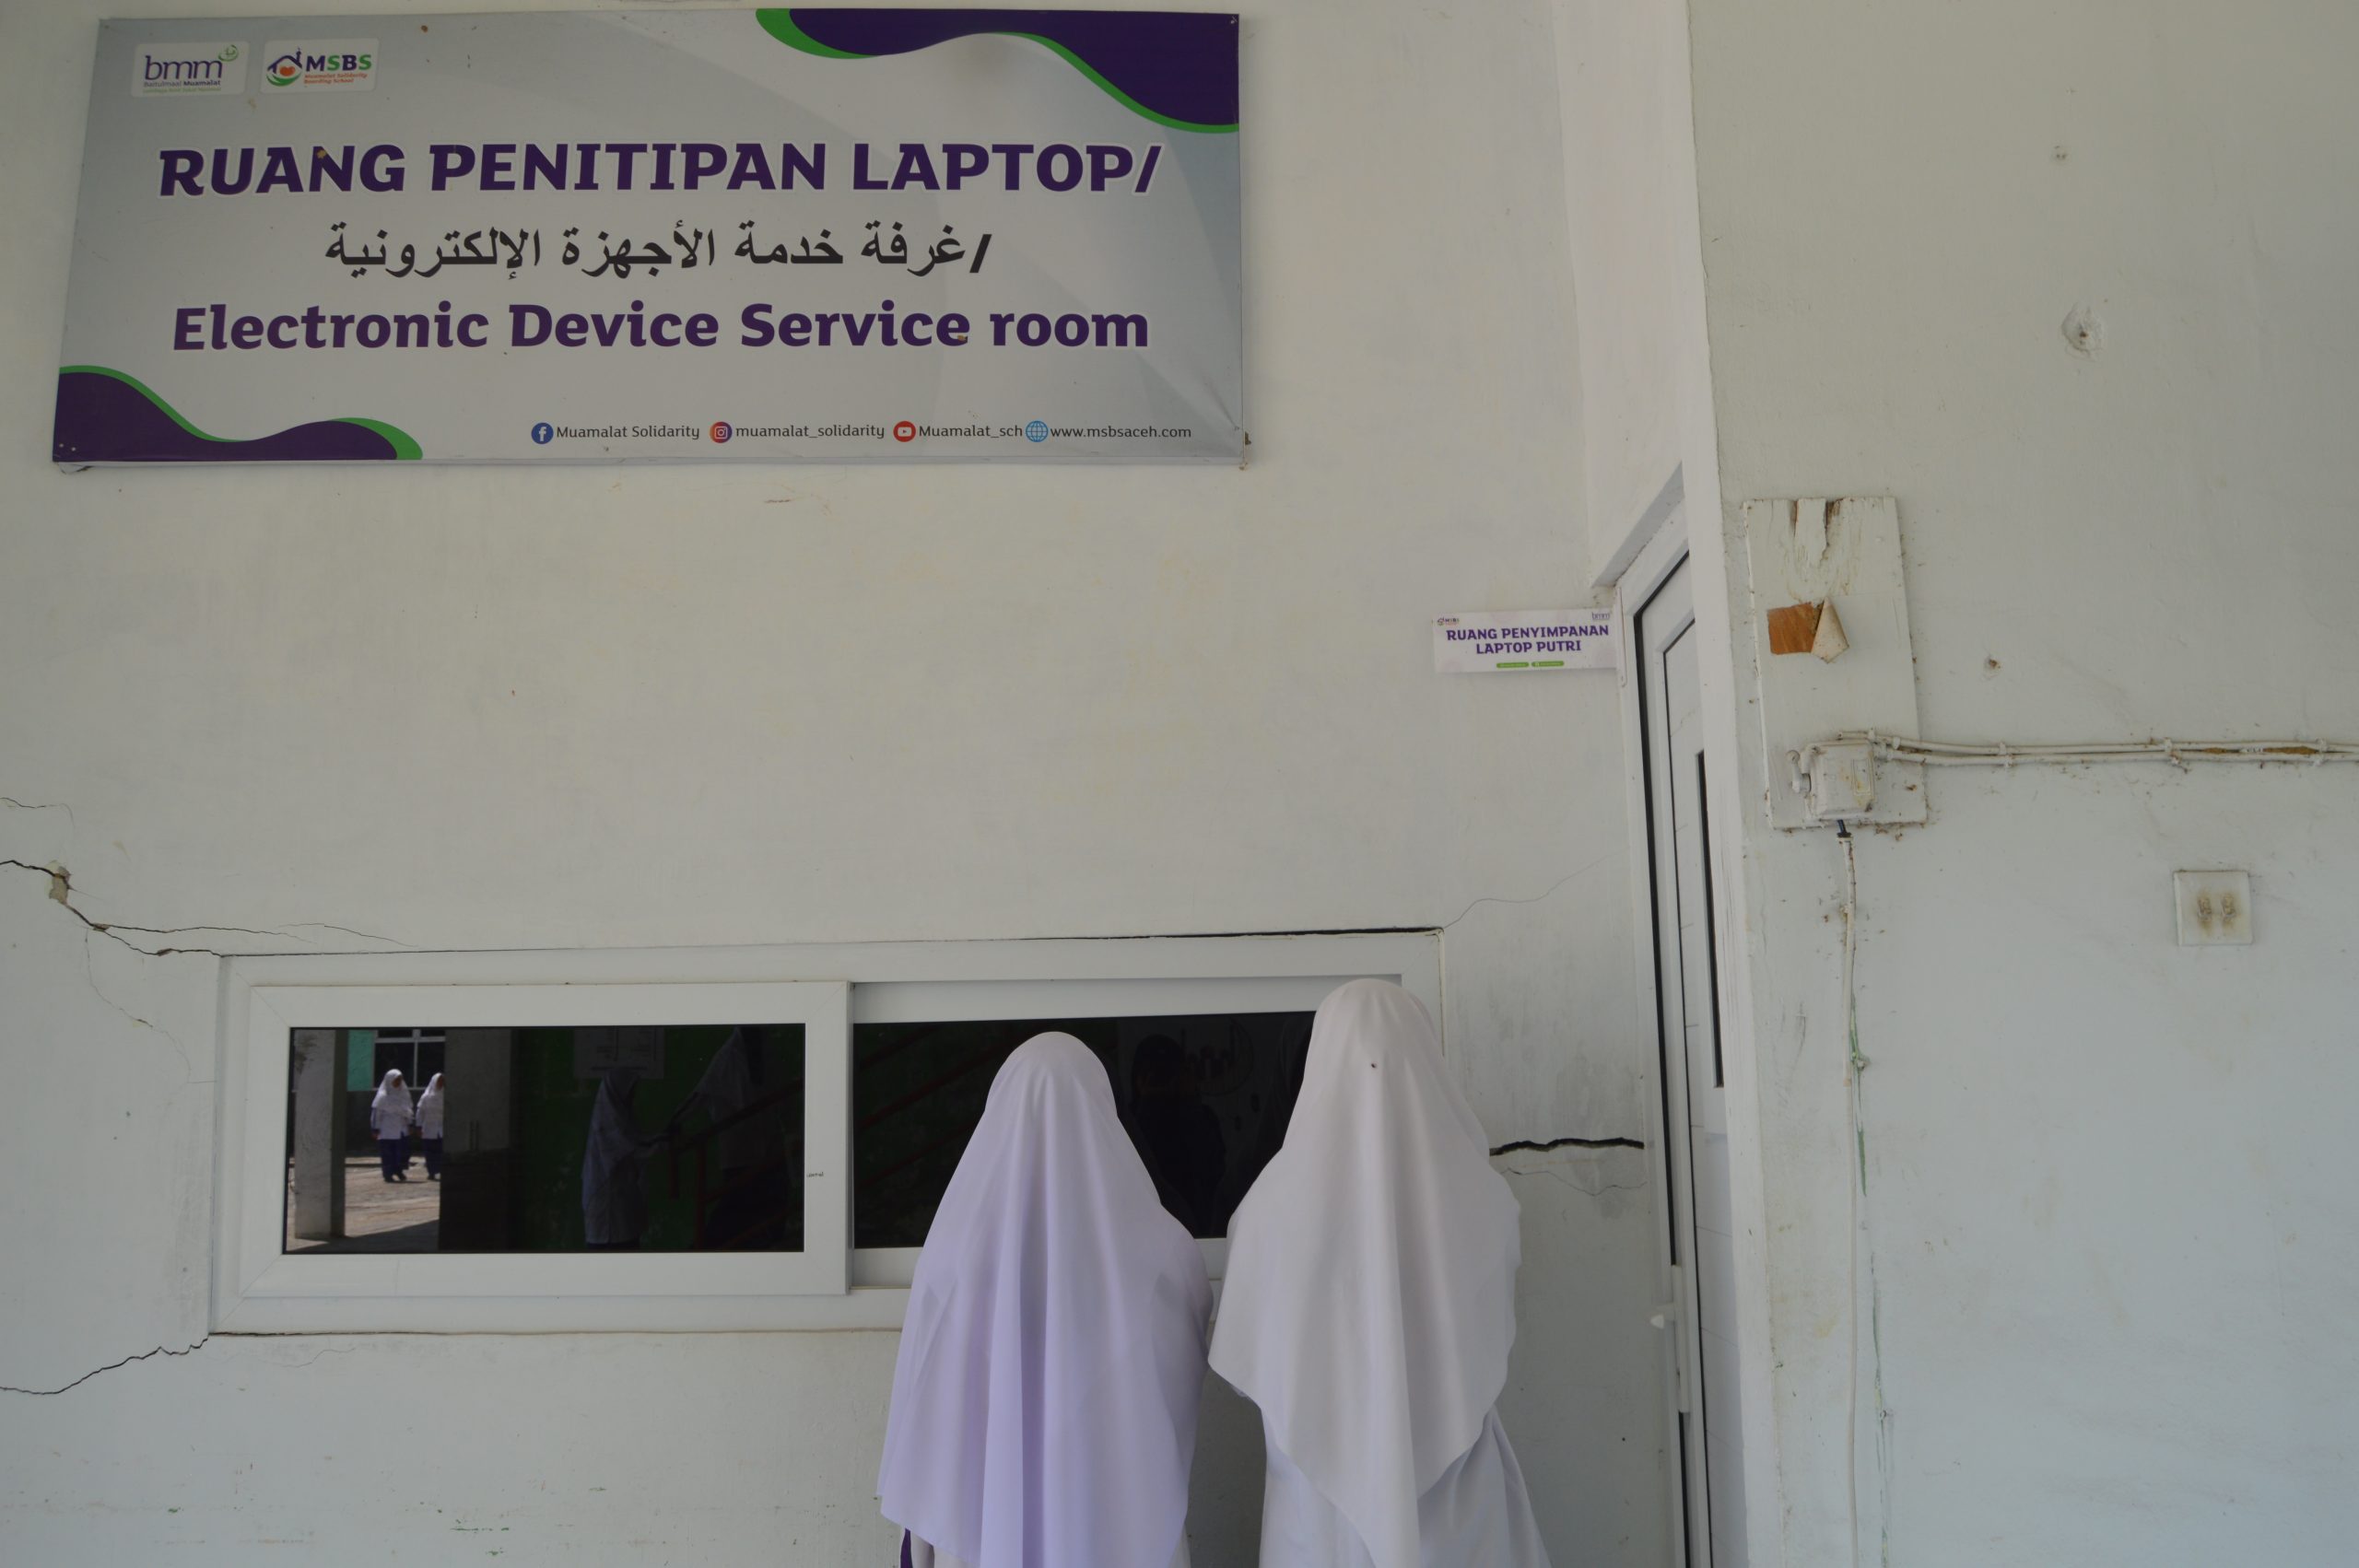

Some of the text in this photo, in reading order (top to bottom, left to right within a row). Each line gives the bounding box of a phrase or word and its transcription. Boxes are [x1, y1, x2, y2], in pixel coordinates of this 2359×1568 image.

[145, 54, 223, 81] bmm
[305, 53, 372, 73] MSBS
[159, 143, 1162, 197] RUANG PENITIPAN LAPTOP/
[324, 221, 541, 280] الإلكترونية
[561, 219, 715, 279] الأجهزة
[734, 219, 844, 265] خدمة
[173, 299, 1149, 350] Electronic Device Service room
[556, 425, 700, 440] Muamalat Solidarity
[735, 424, 886, 440] muamalat_solidarity
[919, 424, 1023, 439] Muamalat_sch
[1050, 425, 1191, 439] www.msbsaceh.com
[1446, 625, 1609, 641] RUANG PENYIMPANAN
[1475, 640, 1581, 655] LAPTOP PUTRI
